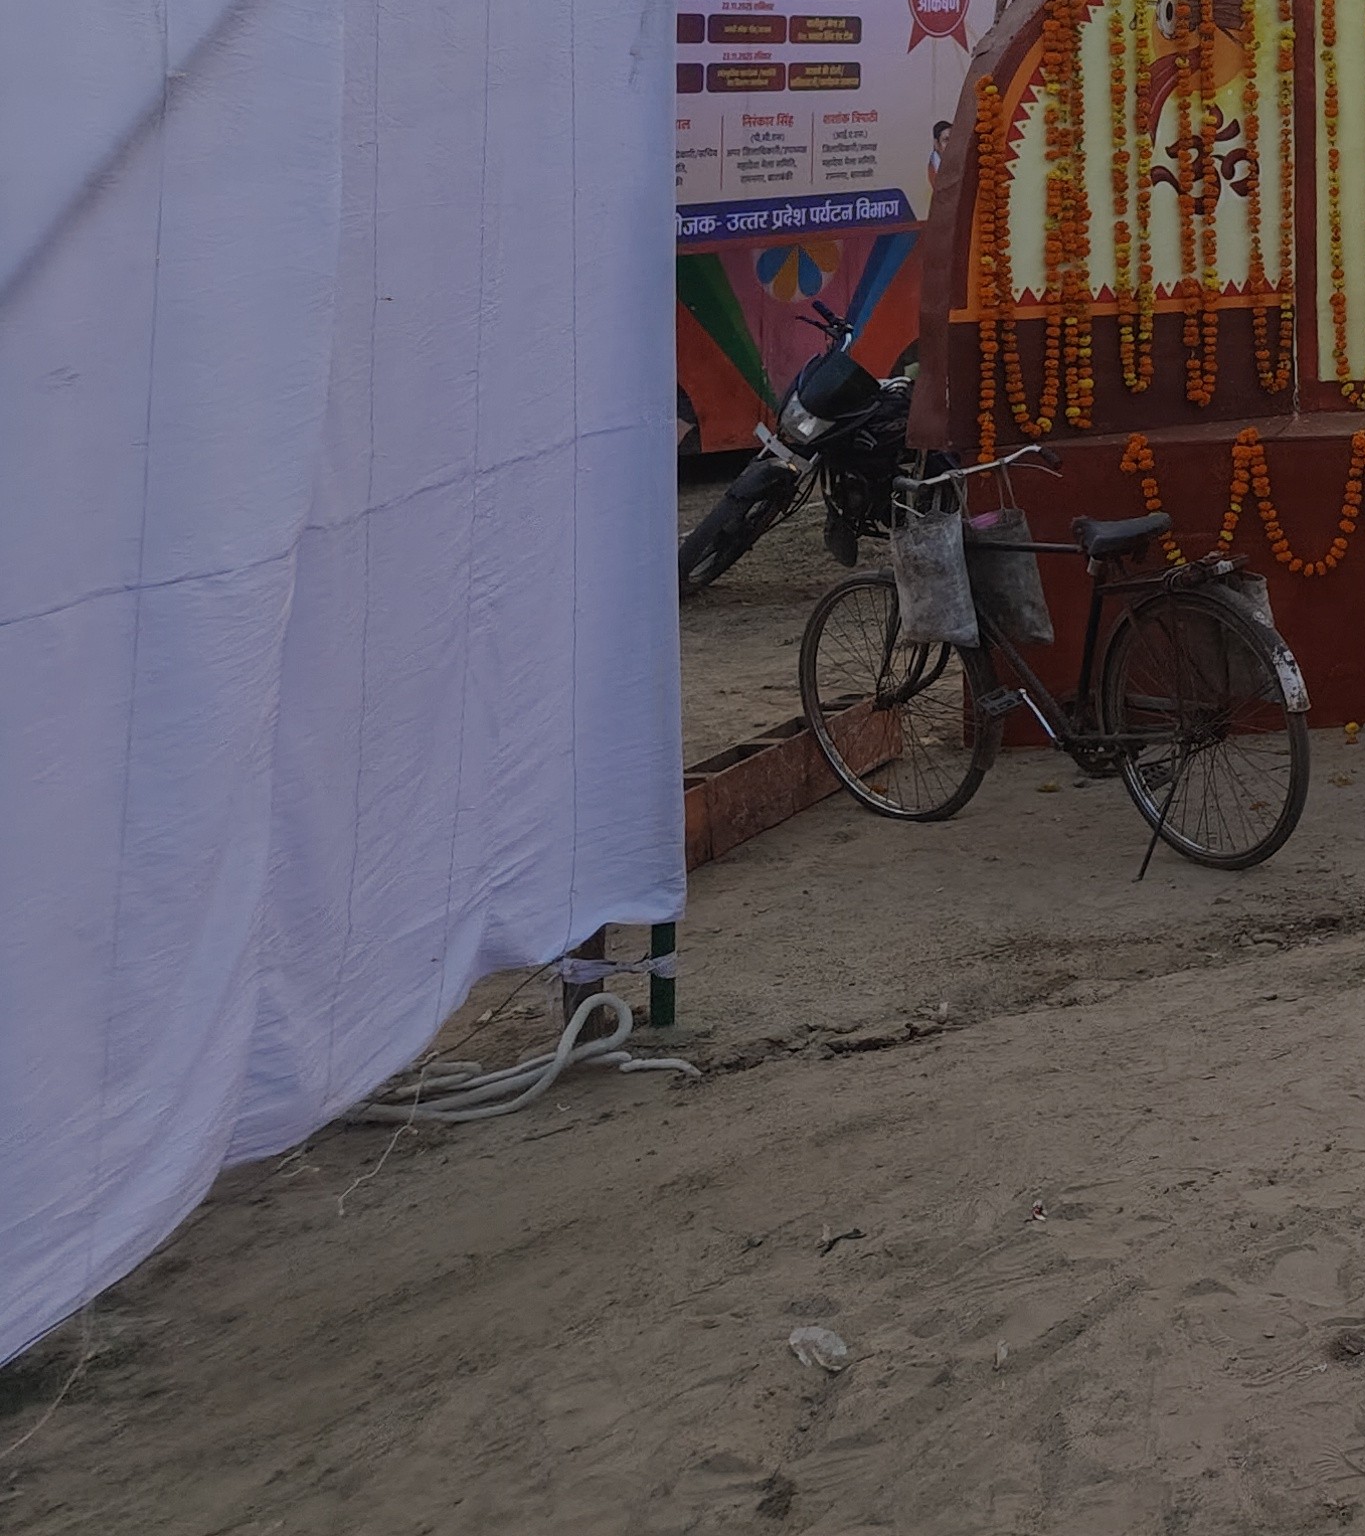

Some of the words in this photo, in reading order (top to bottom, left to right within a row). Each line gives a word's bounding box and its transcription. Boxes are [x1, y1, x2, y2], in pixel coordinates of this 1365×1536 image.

[726, 210, 768, 232] उत्तर
[772, 203, 807, 229] प्रदेश
[809, 199, 853, 224] पर्यटन
[855, 196, 899, 221] विभाग
